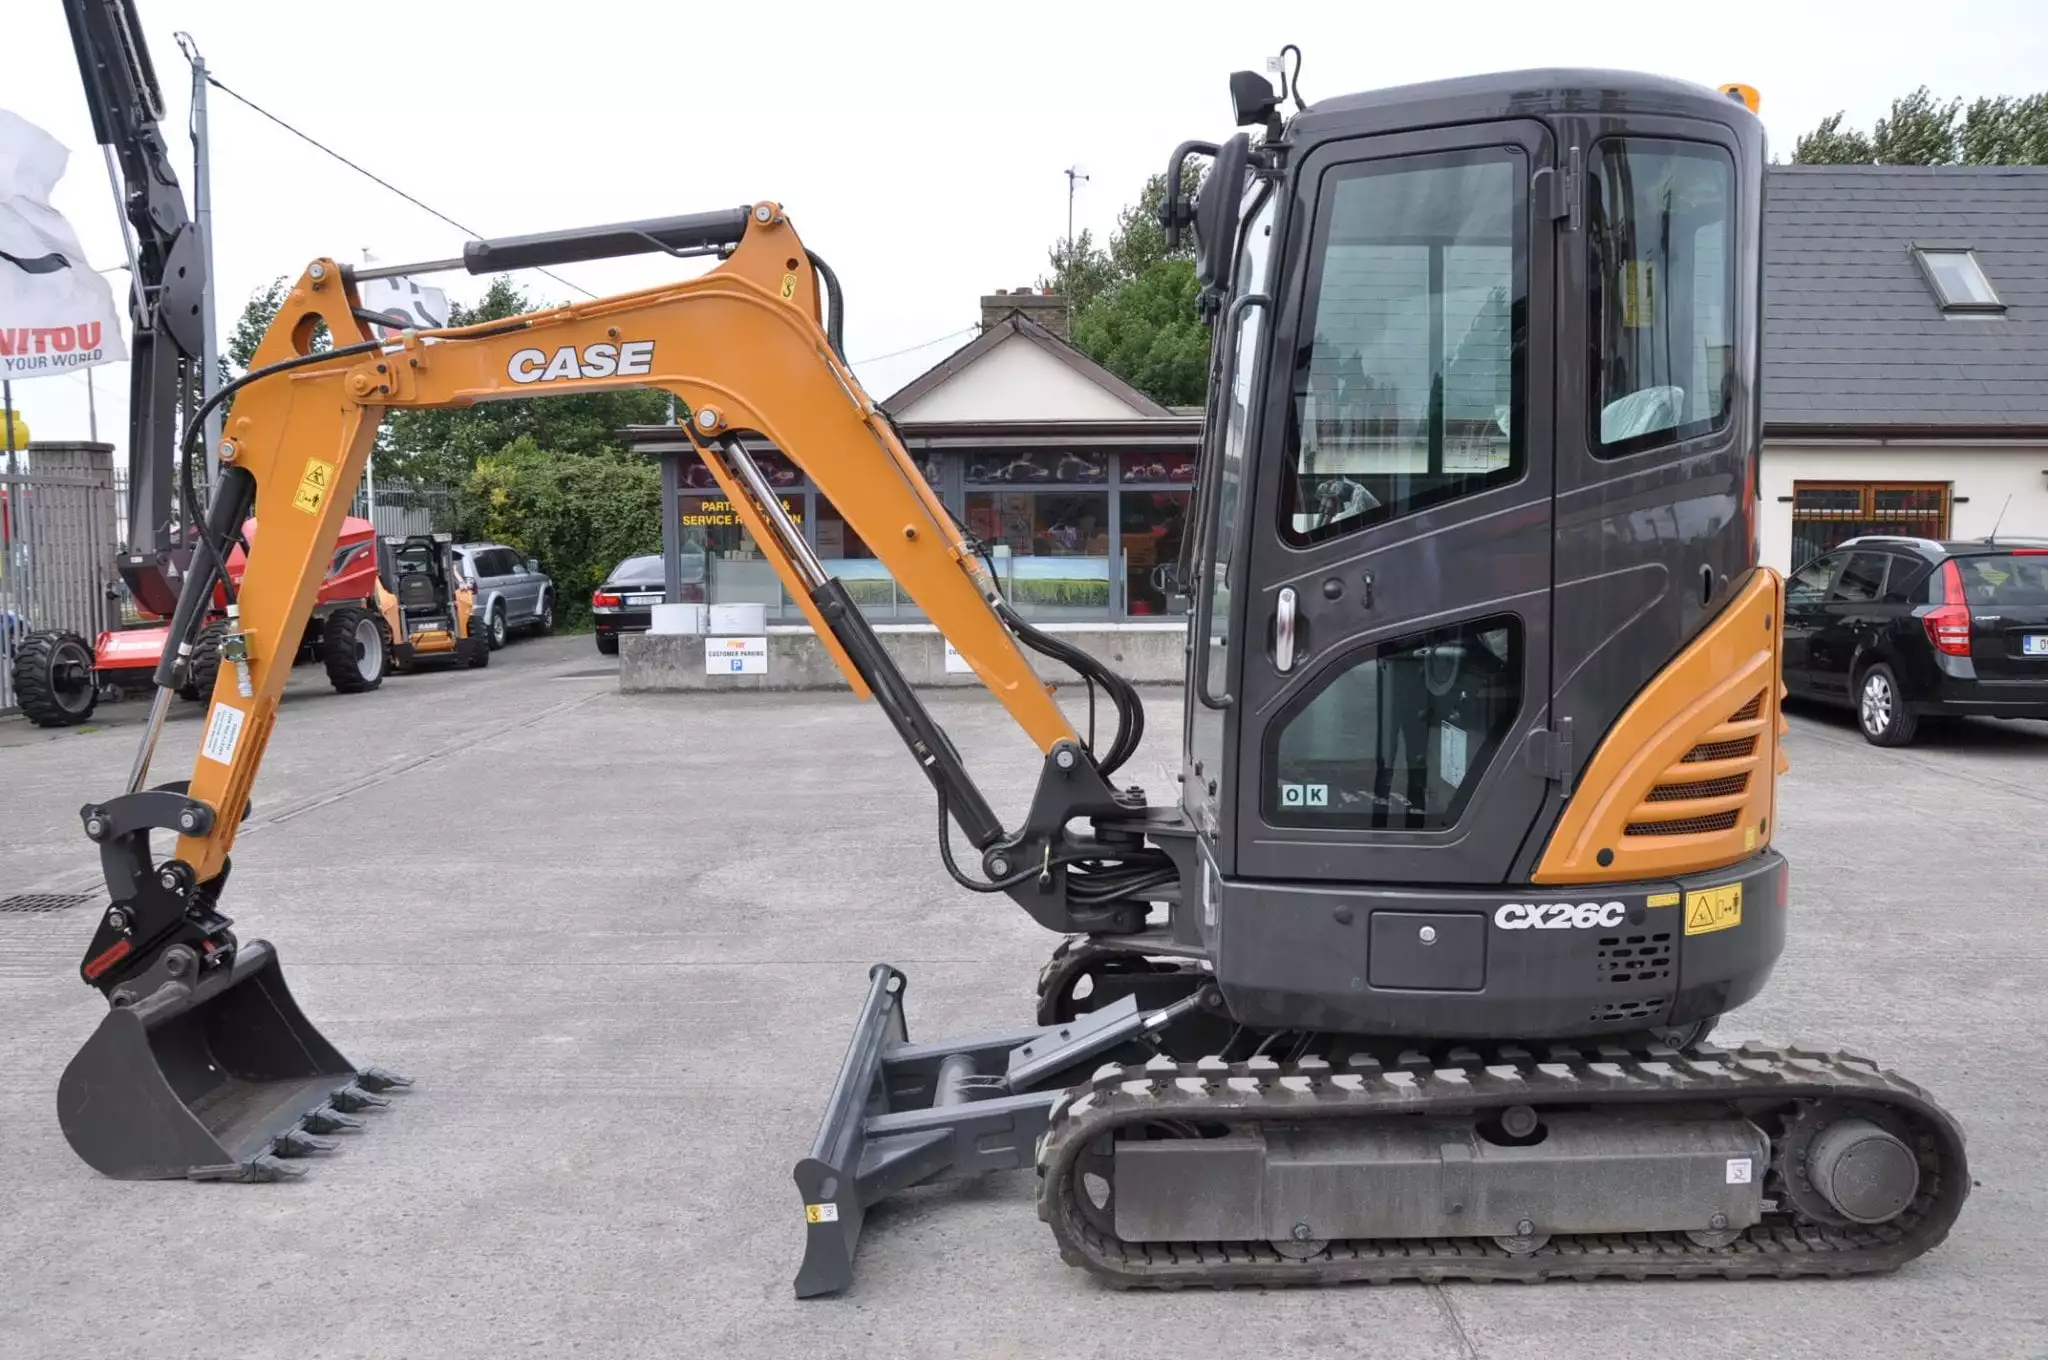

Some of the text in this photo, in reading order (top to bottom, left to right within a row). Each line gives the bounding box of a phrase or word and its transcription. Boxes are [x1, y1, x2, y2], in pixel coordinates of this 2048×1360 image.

[6, 349, 103, 371] YOUR WORLD
[507, 340, 656, 384] CASE
[682, 514, 732, 526] SERVICE
[1494, 901, 1626, 930] CX26C
